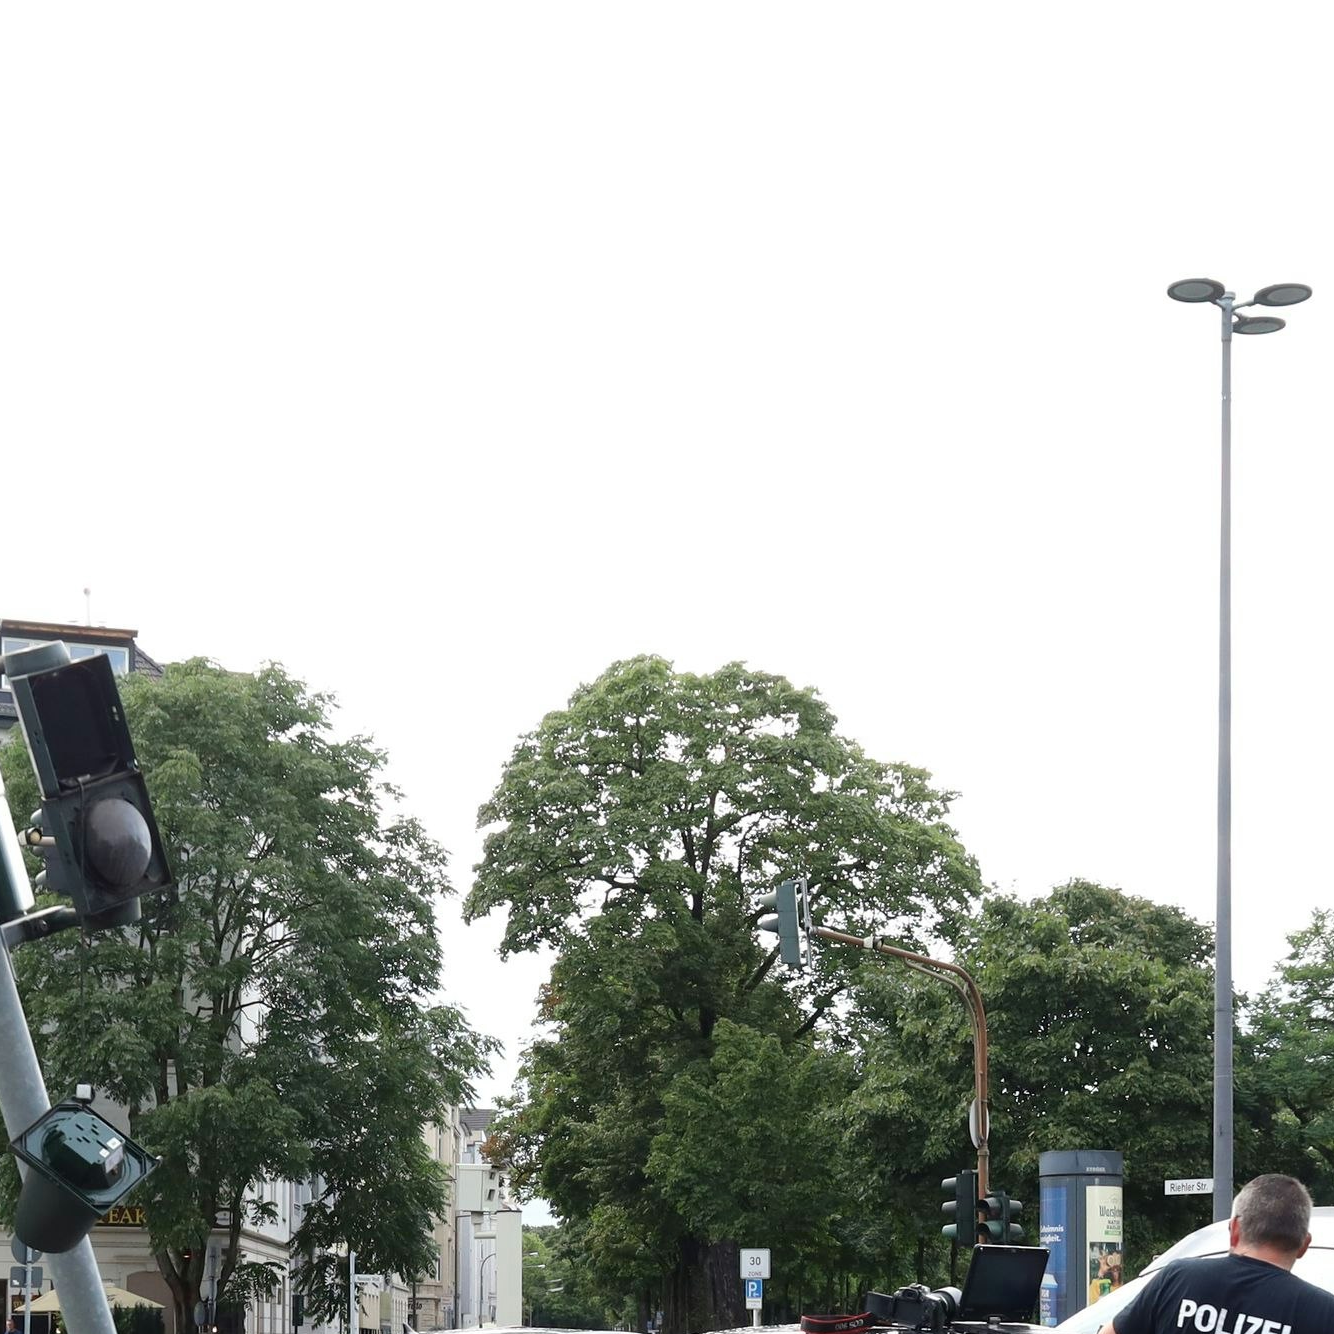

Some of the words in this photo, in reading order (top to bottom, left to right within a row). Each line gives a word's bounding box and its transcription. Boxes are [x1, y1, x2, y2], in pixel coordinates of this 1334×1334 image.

[1170, 1183, 1195, 1192] Riehler
[1196, 1182, 1208, 1191] Str.
[749, 1256, 762, 1266] 30
